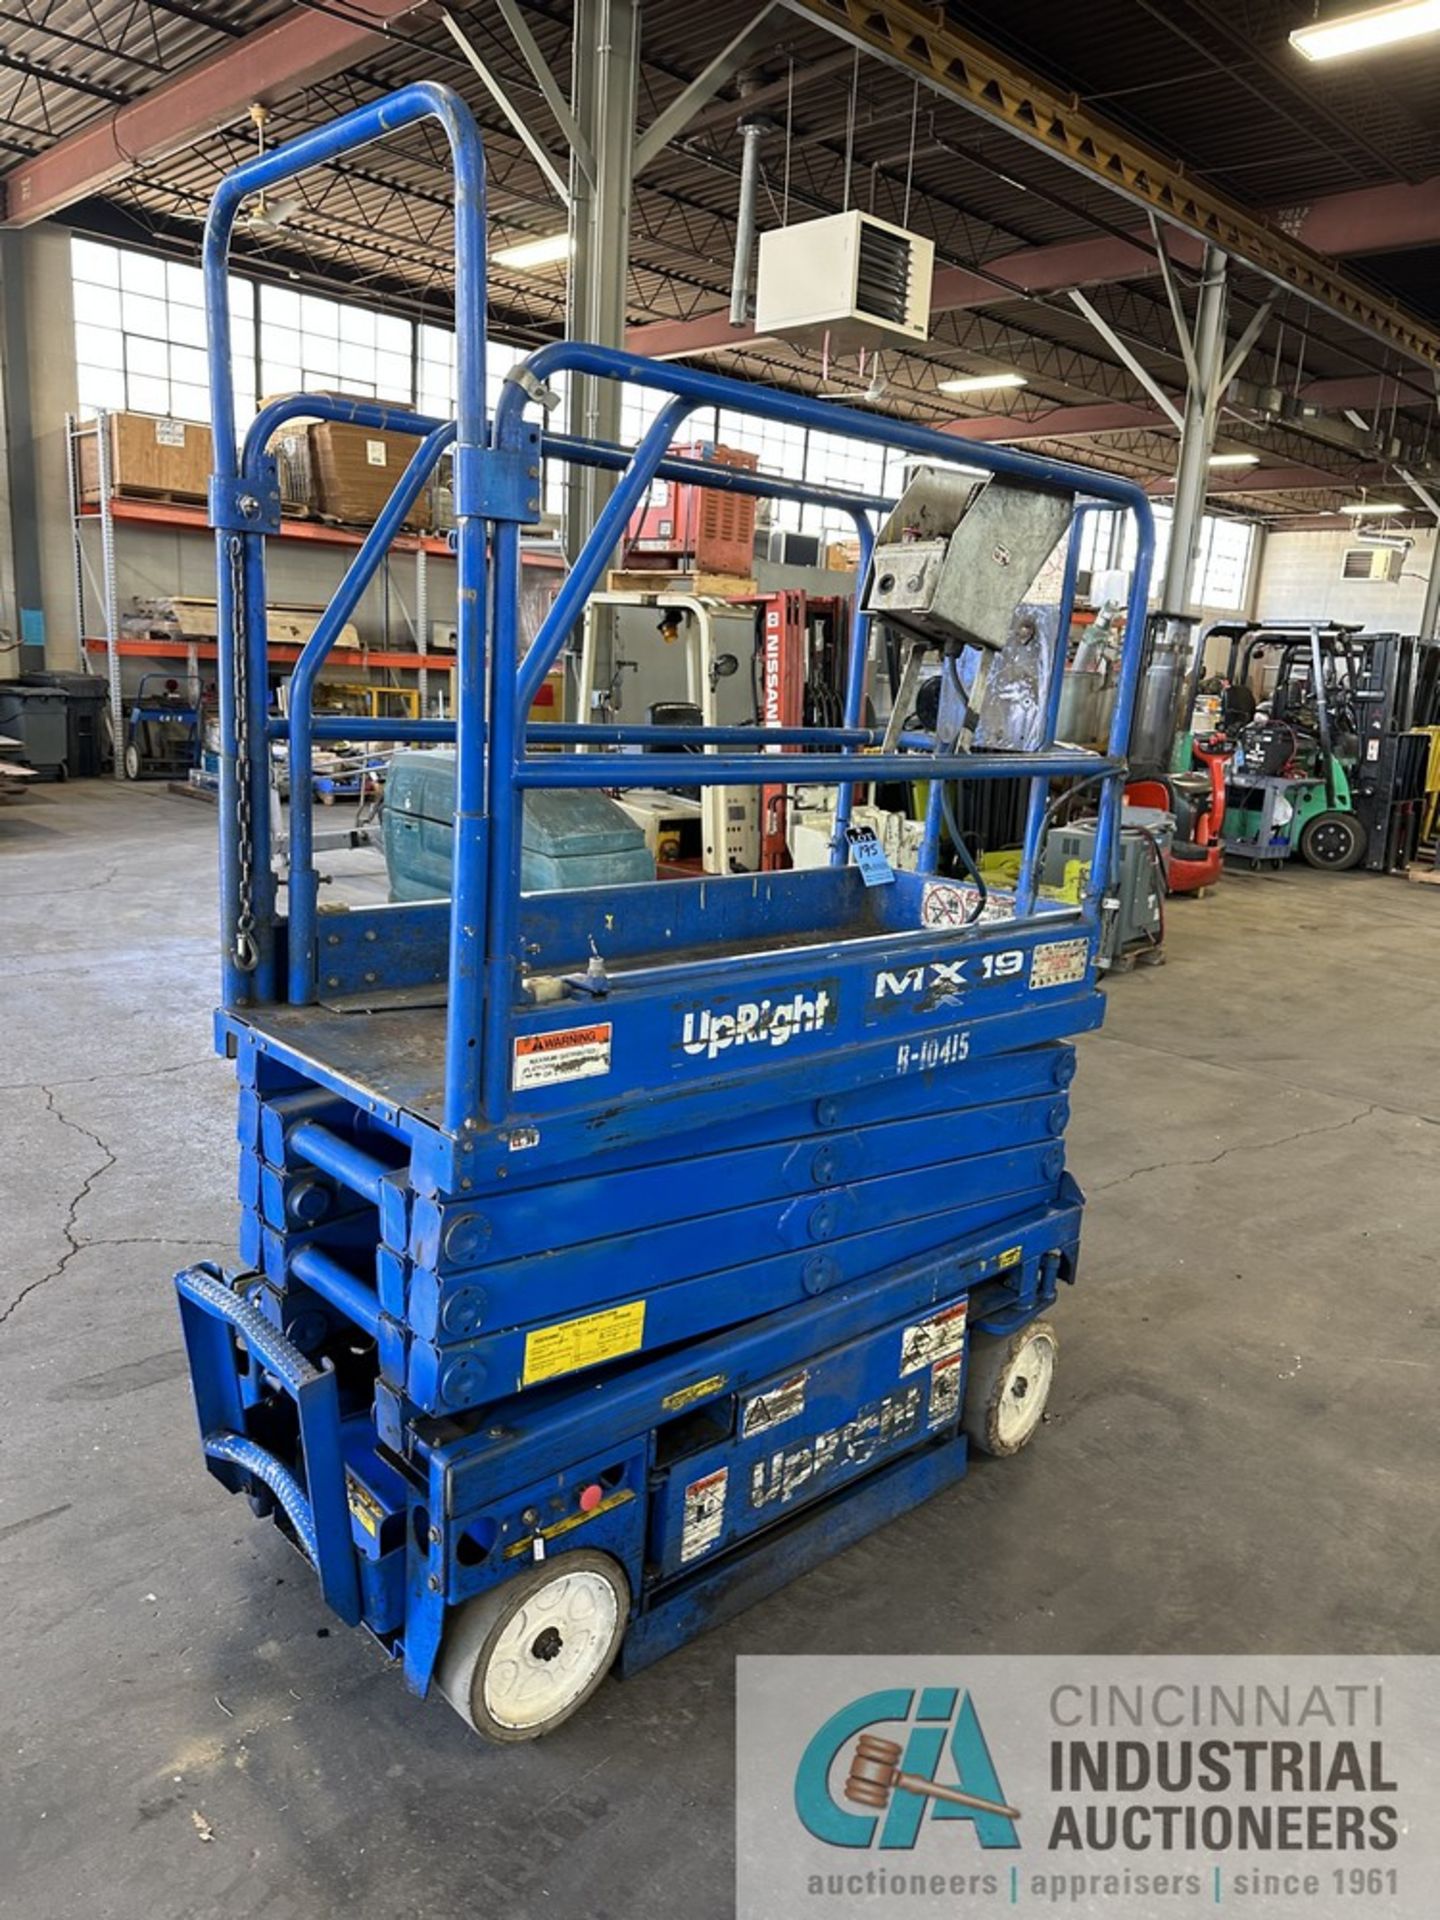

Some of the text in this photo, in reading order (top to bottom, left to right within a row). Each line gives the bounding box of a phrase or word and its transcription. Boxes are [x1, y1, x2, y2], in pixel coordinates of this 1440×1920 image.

[766, 634, 780, 723] NISSAN
[982, 951, 1024, 979] 19
[544, 1031, 596, 1049] WARNING
[683, 991, 829, 1059] UpRight
